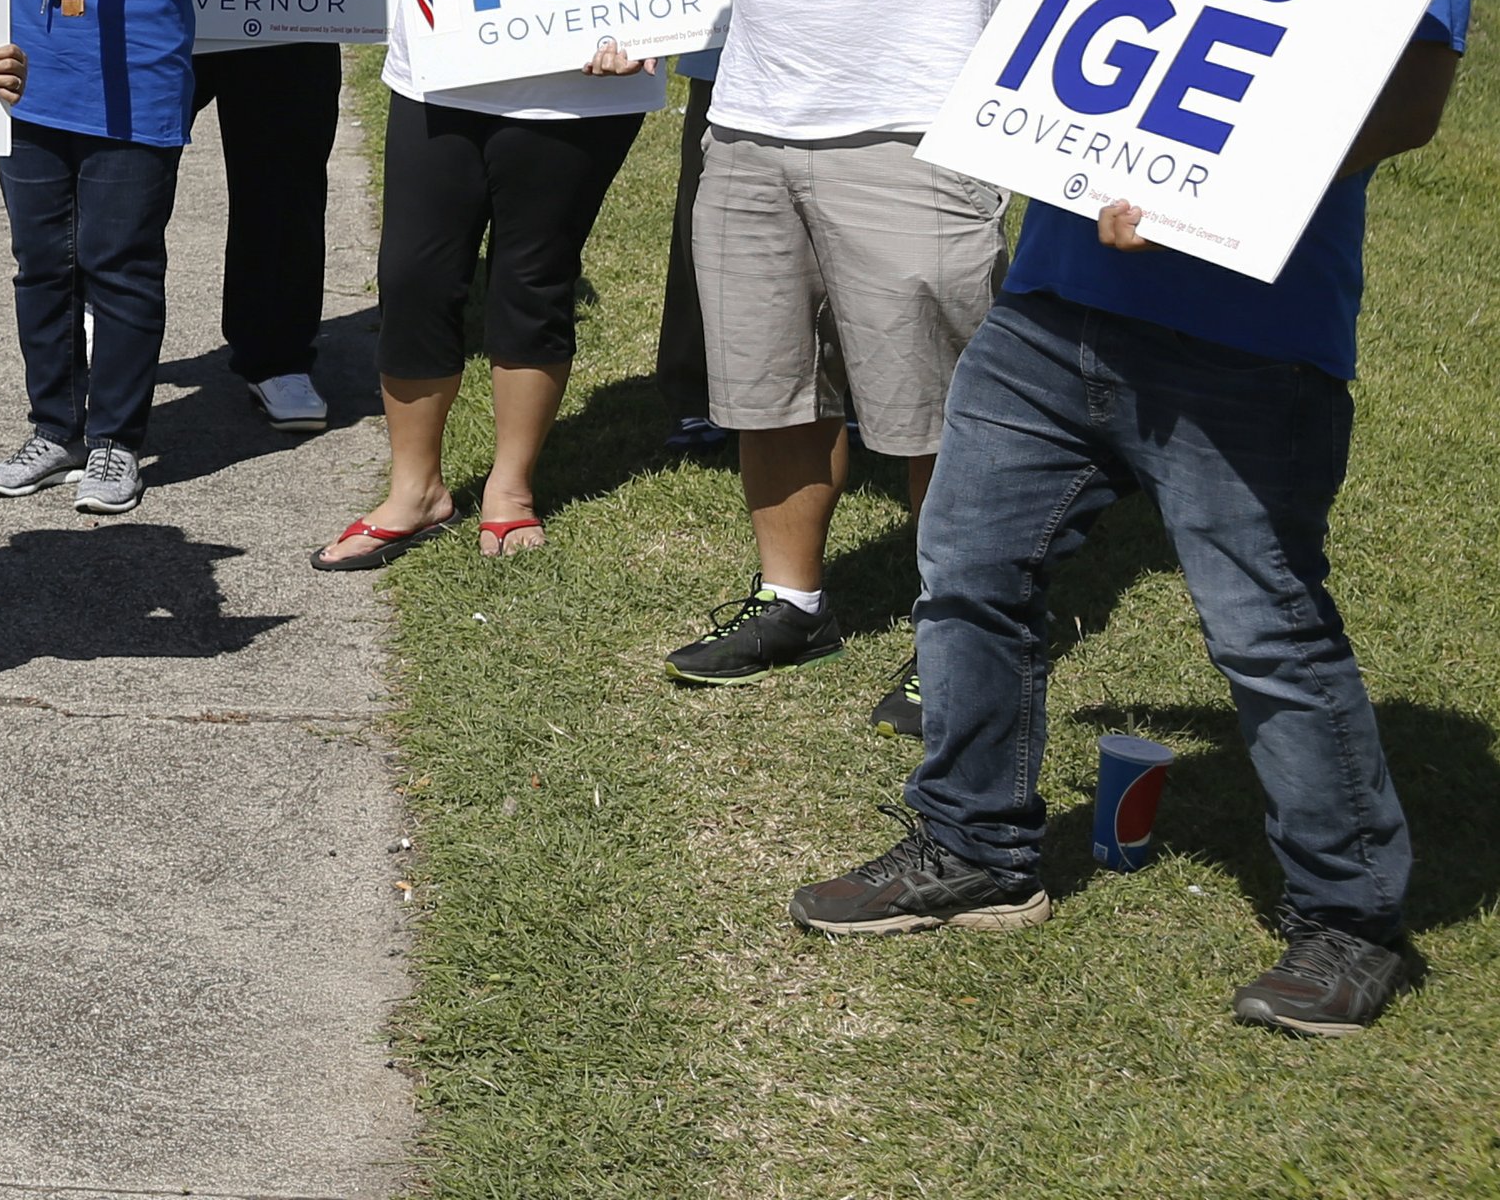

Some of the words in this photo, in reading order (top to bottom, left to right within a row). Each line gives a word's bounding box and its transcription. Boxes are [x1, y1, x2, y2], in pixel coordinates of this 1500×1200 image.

[653, 34, 679, 44] approved
[688, 30, 703, 38] David
[975, 99, 1210, 198] GOVERNOR
[1089, 189, 1100, 201] Paid
[1101, 194, 1111, 203] for
[1152, 214, 1159, 224] by
[1159, 214, 1175, 228] David
[1187, 223, 1196, 234] for
[1196, 227, 1225, 243] Governor
